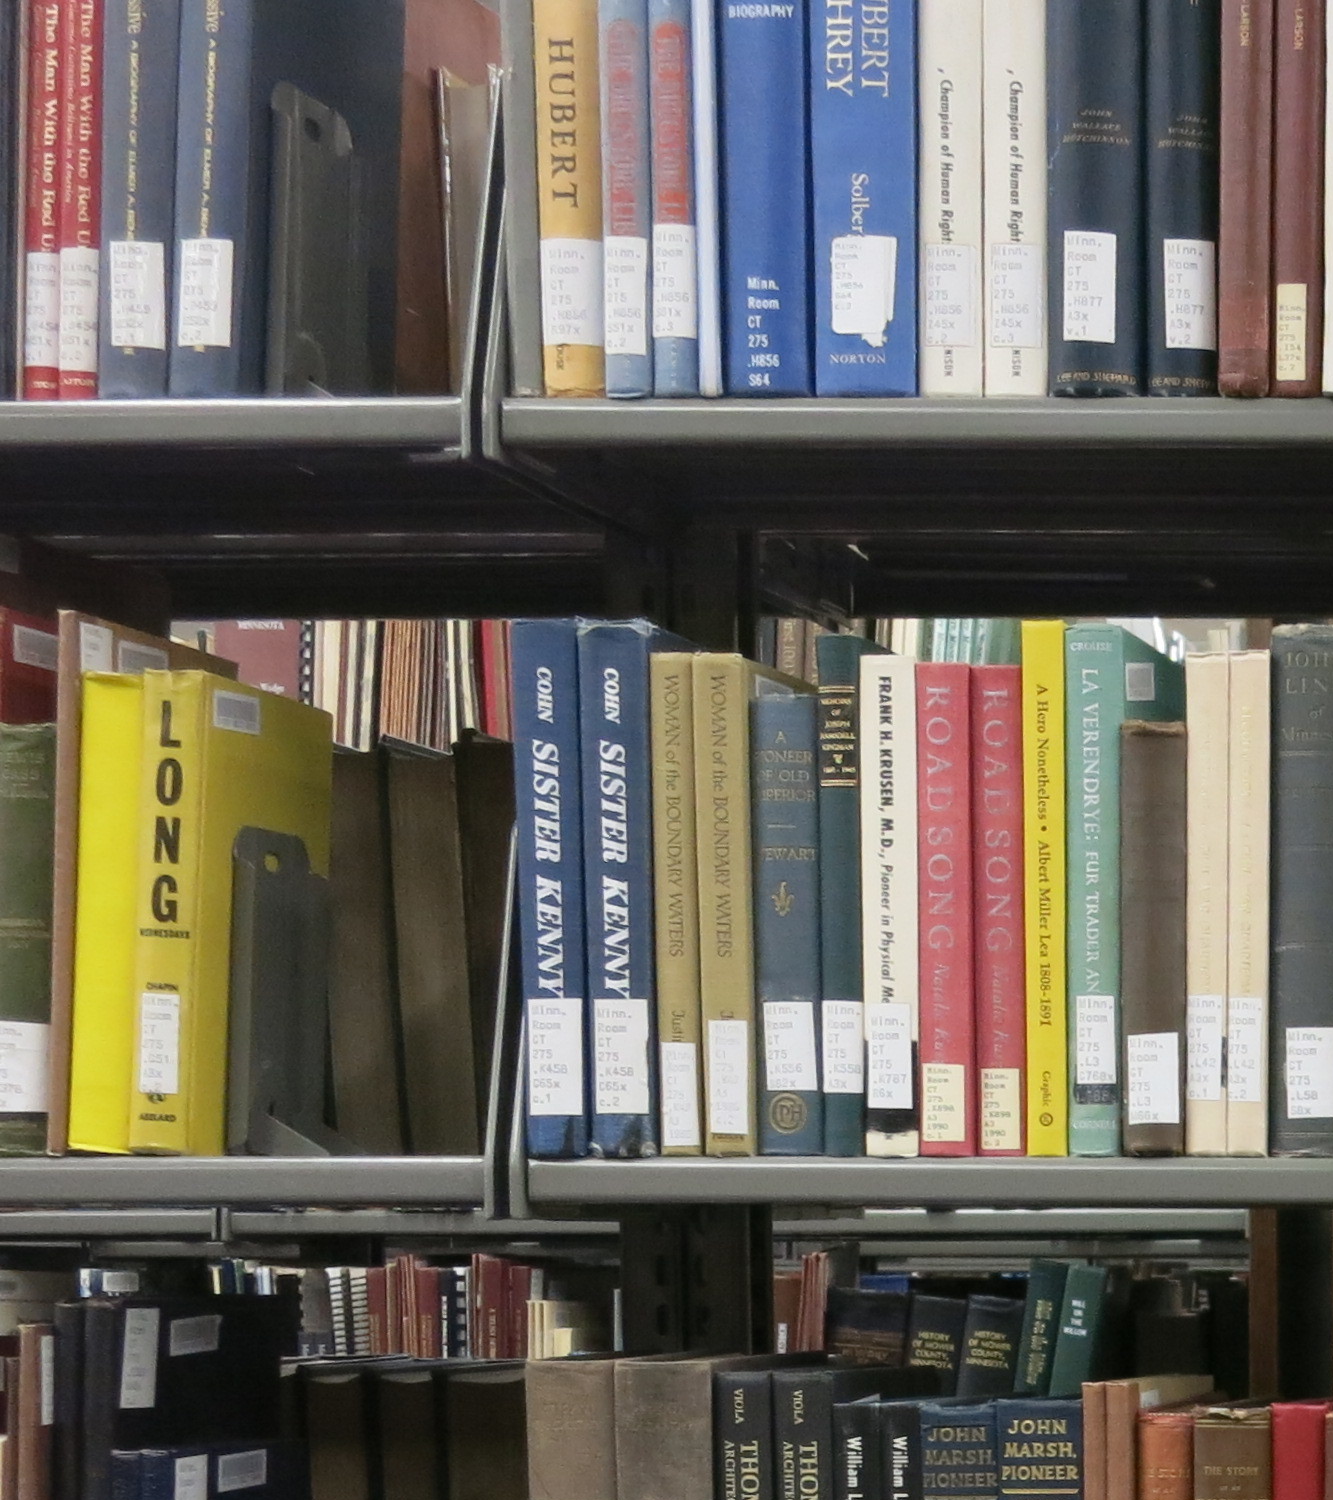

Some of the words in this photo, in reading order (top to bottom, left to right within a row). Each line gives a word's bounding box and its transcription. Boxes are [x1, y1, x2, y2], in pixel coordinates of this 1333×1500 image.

[728, 4, 794, 20] BIOGRAPHY
[548, 36, 579, 208] HUBERT
[939, 80, 954, 139] Champion
[940, 145, 954, 157] of
[940, 162, 953, 205] Human
[747, 276, 780, 291] Minn.
[747, 296, 780, 310] Room
[747, 316, 762, 329] CT
[748, 333, 769, 348] 275
[748, 354, 780, 368] .H856
[829, 353, 886, 365] NORTON
[748, 373, 770, 387] S64
[536, 667, 554, 724] COHN
[1036, 684, 1049, 695] A
[1082, 668, 1097, 693] LA
[878, 675, 893, 725] FRANK
[1036, 700, 1049, 733] Hero
[879, 730, 893, 745] H.
[925, 685, 953, 811] ROAD
[876, 749, 894, 812] KRUSEN,
[1036, 738, 1050, 821] Nonetheless
[532, 739, 561, 863] SISTER
[1037, 840, 1051, 883] Albert
[1084, 851, 1099, 885] FUR
[879, 864, 893, 909] Pioneer
[926, 827, 954, 950] SONG
[880, 914, 893, 926] in
[1037, 888, 1051, 930] Miller
[535, 875, 565, 999] KENNY
[1085, 892, 1100, 961] TRADER
[879, 930, 895, 980] Physical
[1038, 933, 1051, 957] Lea
[1038, 962, 1052, 1026] 1808-1891
[1008, 1420, 1067, 1435] JOHN
[1002, 1464, 1079, 1481] PIONEER
